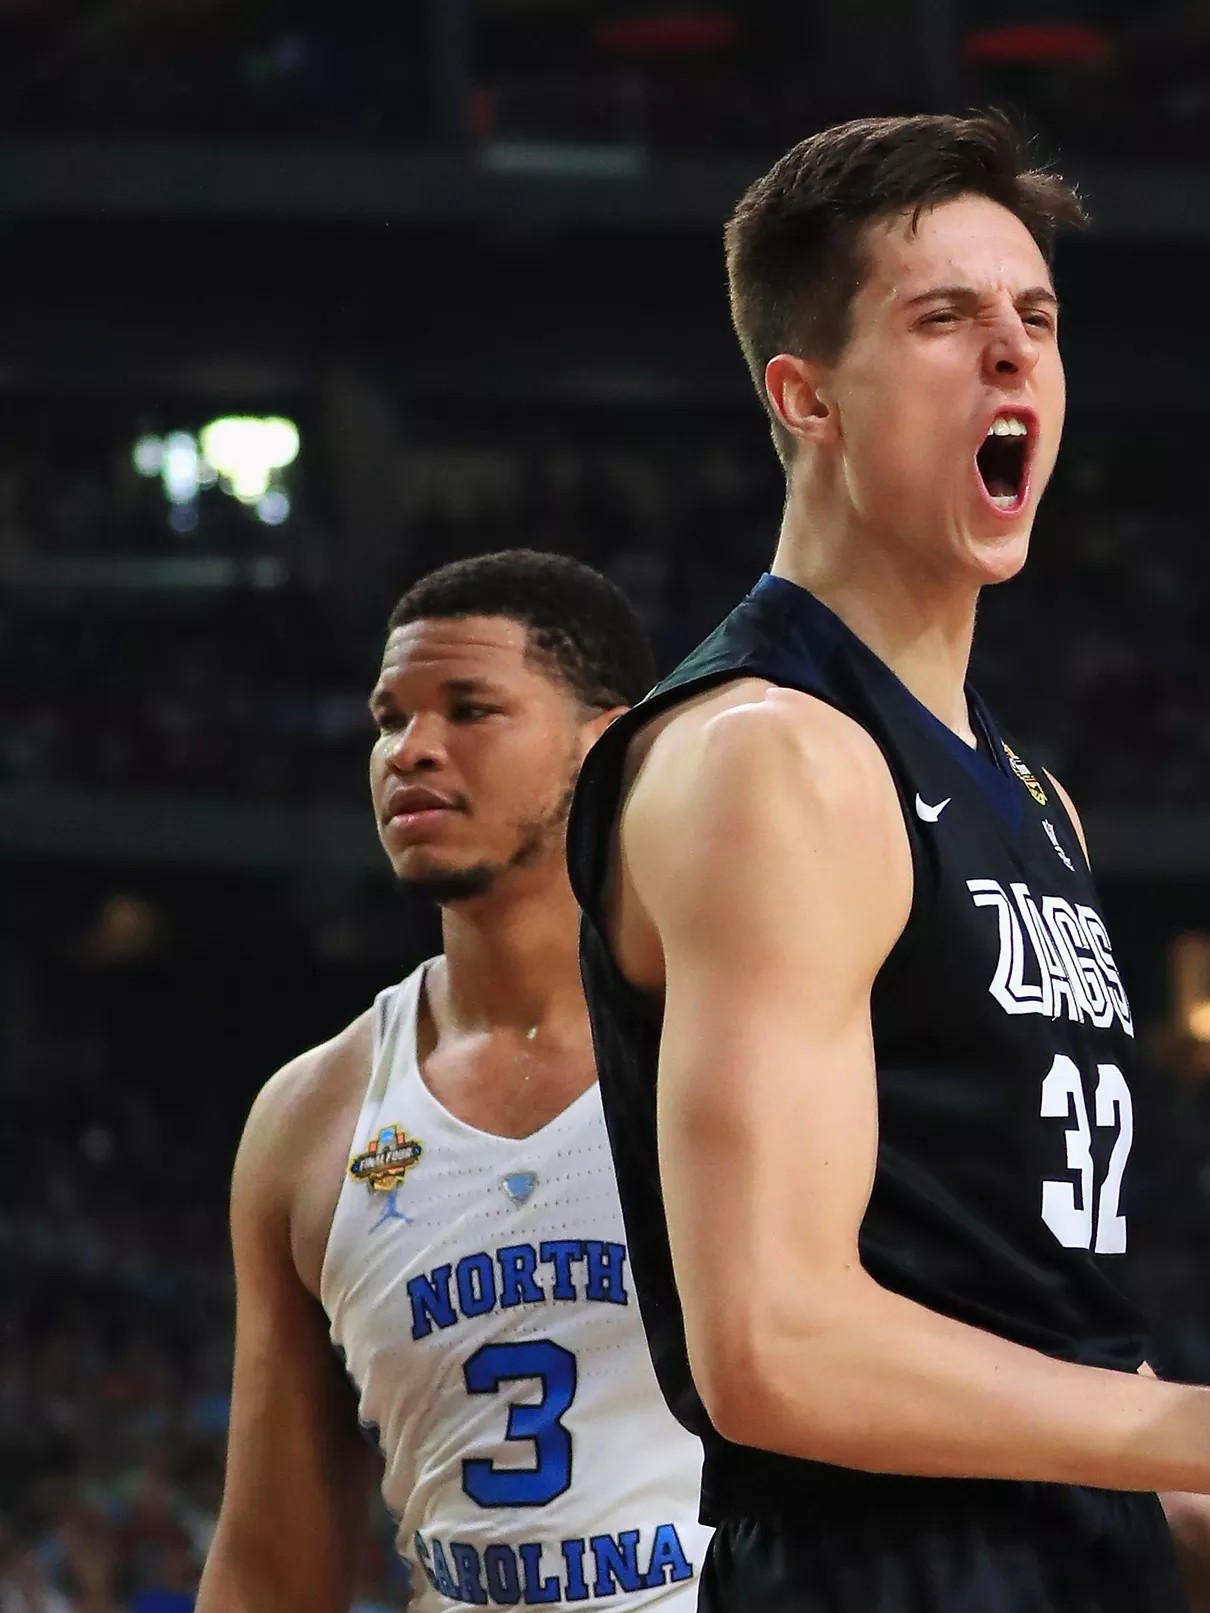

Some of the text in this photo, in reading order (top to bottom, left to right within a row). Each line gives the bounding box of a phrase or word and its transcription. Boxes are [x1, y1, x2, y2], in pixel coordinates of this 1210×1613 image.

[966, 879, 1135, 1038] ZAGS
[1040, 1053, 1132, 1254] 32
[407, 1240, 627, 1340] NORTH
[461, 1339, 577, 1508] 3
